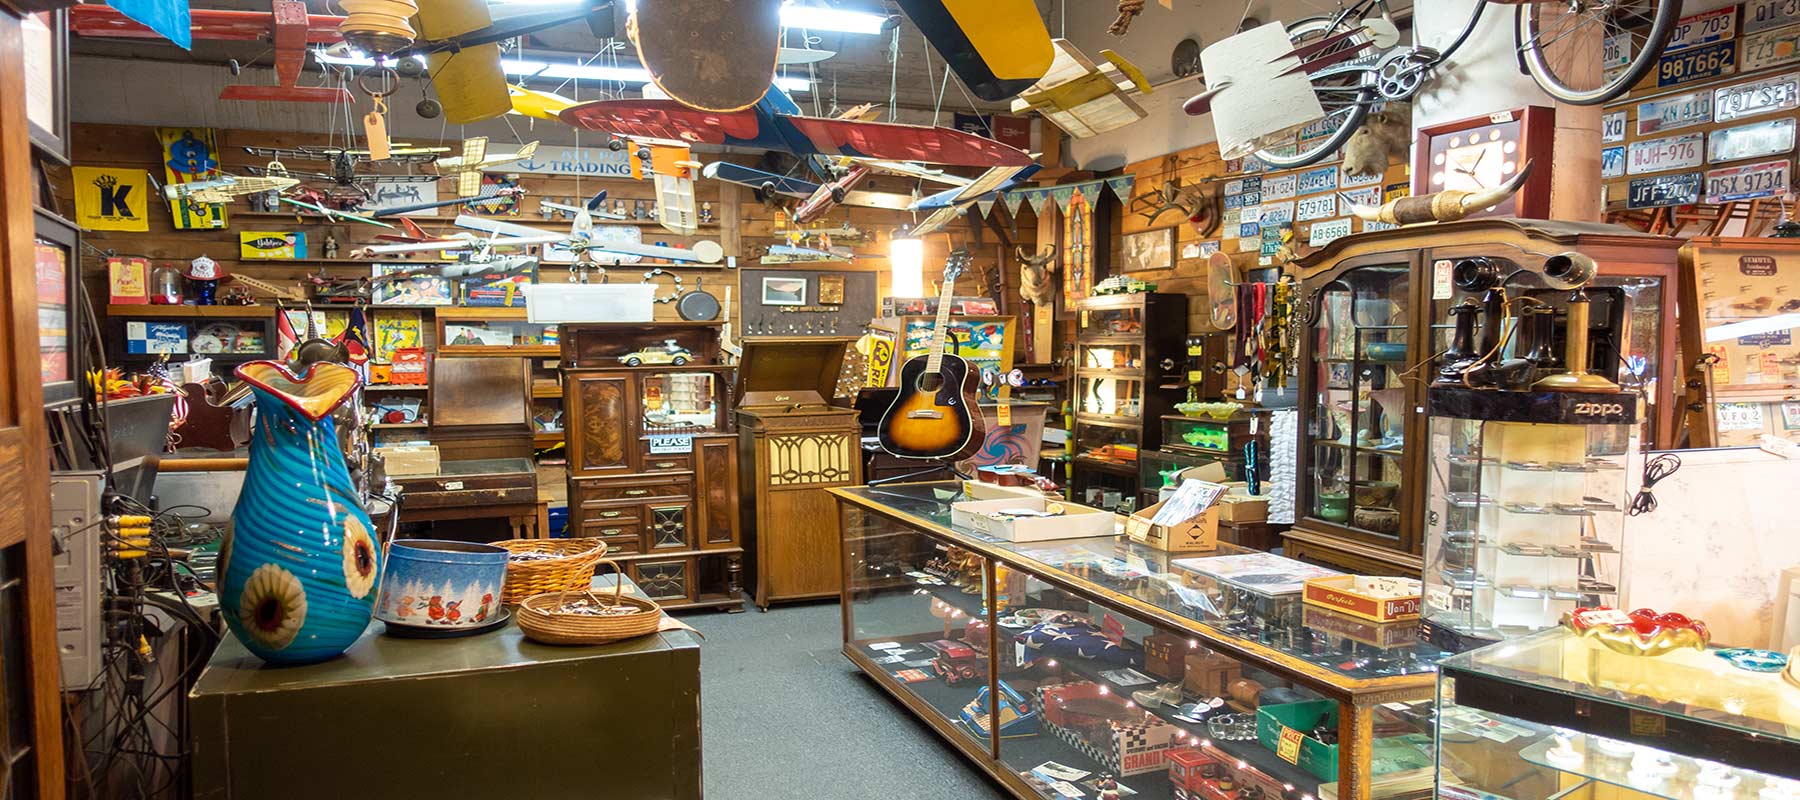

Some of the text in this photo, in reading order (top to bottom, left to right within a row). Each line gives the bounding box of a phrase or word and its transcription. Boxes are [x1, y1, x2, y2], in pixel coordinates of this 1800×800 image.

[1701, 15, 1730, 36] 703
[1661, 48, 1732, 80] 987662
[1683, 99, 1710, 119] 410
[1718, 90, 1754, 115] 797
[561, 149, 589, 160] ALL
[551, 162, 632, 175] TRADING
[1744, 170, 1783, 192] 9734
[100, 185, 134, 217] K
[1299, 198, 1334, 216] 579781
[1574, 403, 1623, 416] zippo
[652, 438, 690, 447] PLEASE
[1387, 602, 1405, 616] Van
[1124, 751, 1161, 770] GRAND
